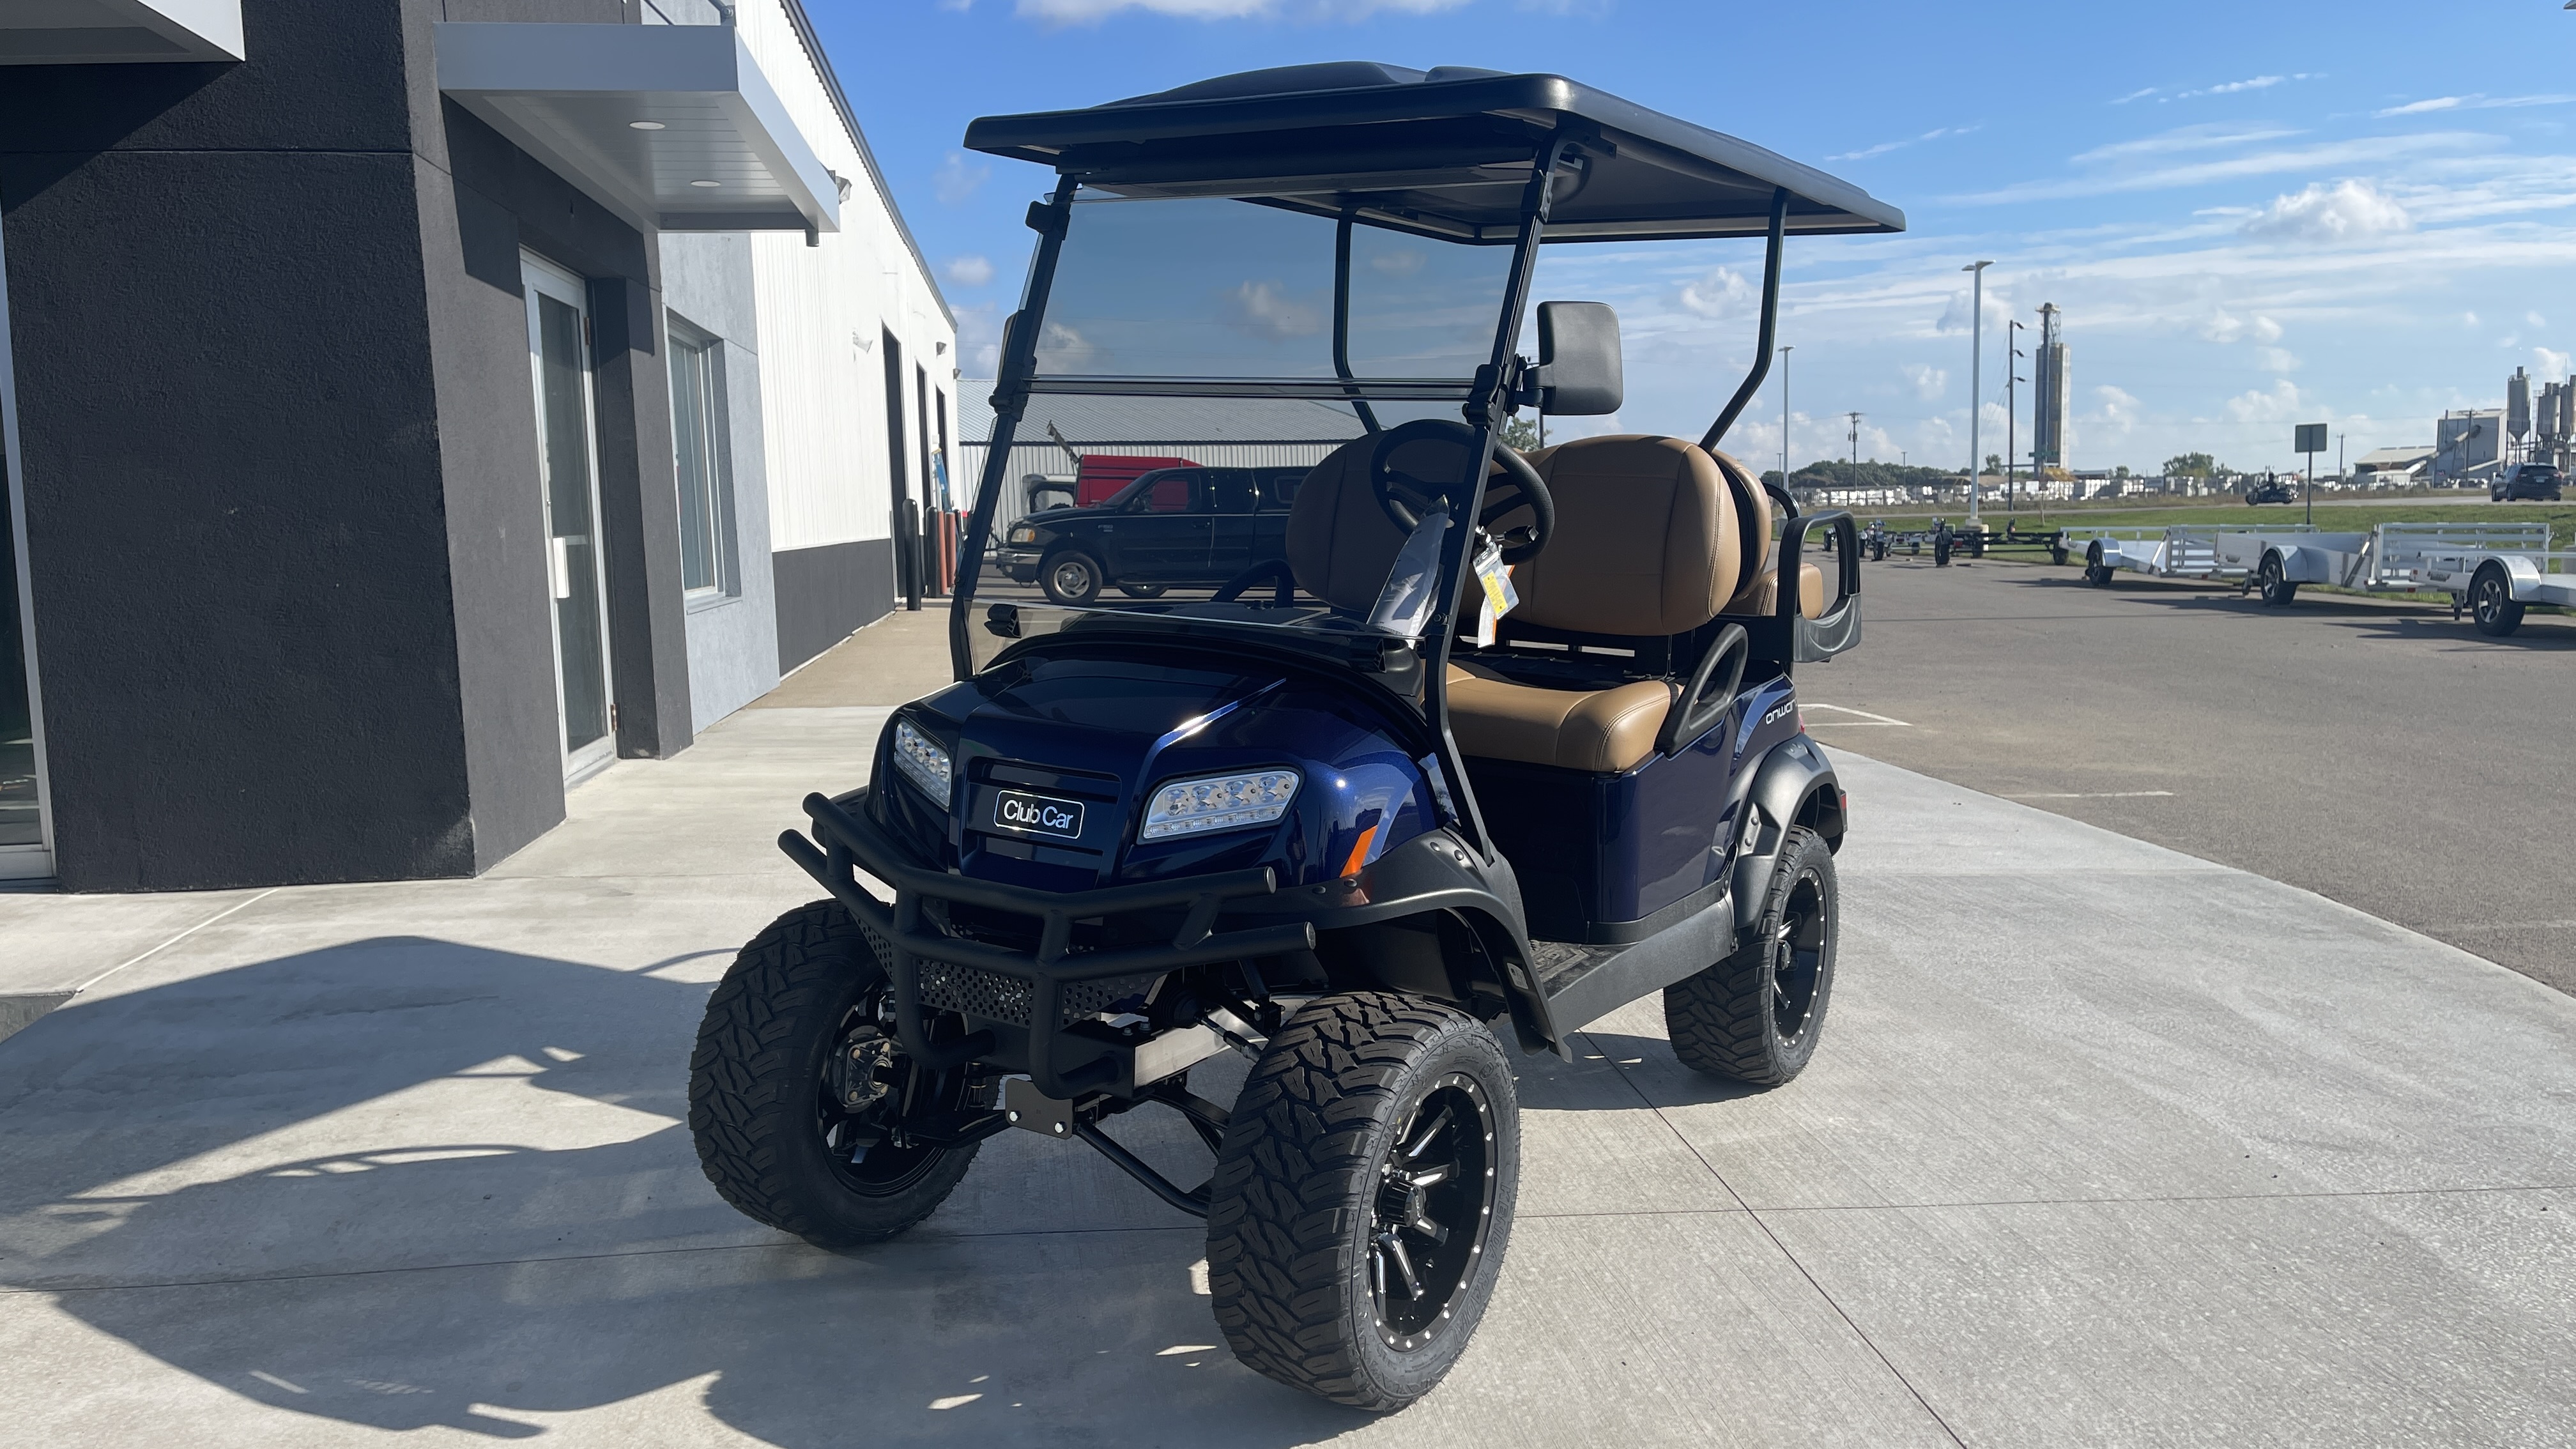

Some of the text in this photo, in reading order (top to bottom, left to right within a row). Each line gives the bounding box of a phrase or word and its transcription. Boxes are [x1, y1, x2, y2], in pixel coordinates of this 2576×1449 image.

[1004, 799, 1074, 829] Club Car
[1485, 1181, 1512, 1264] KENDA
